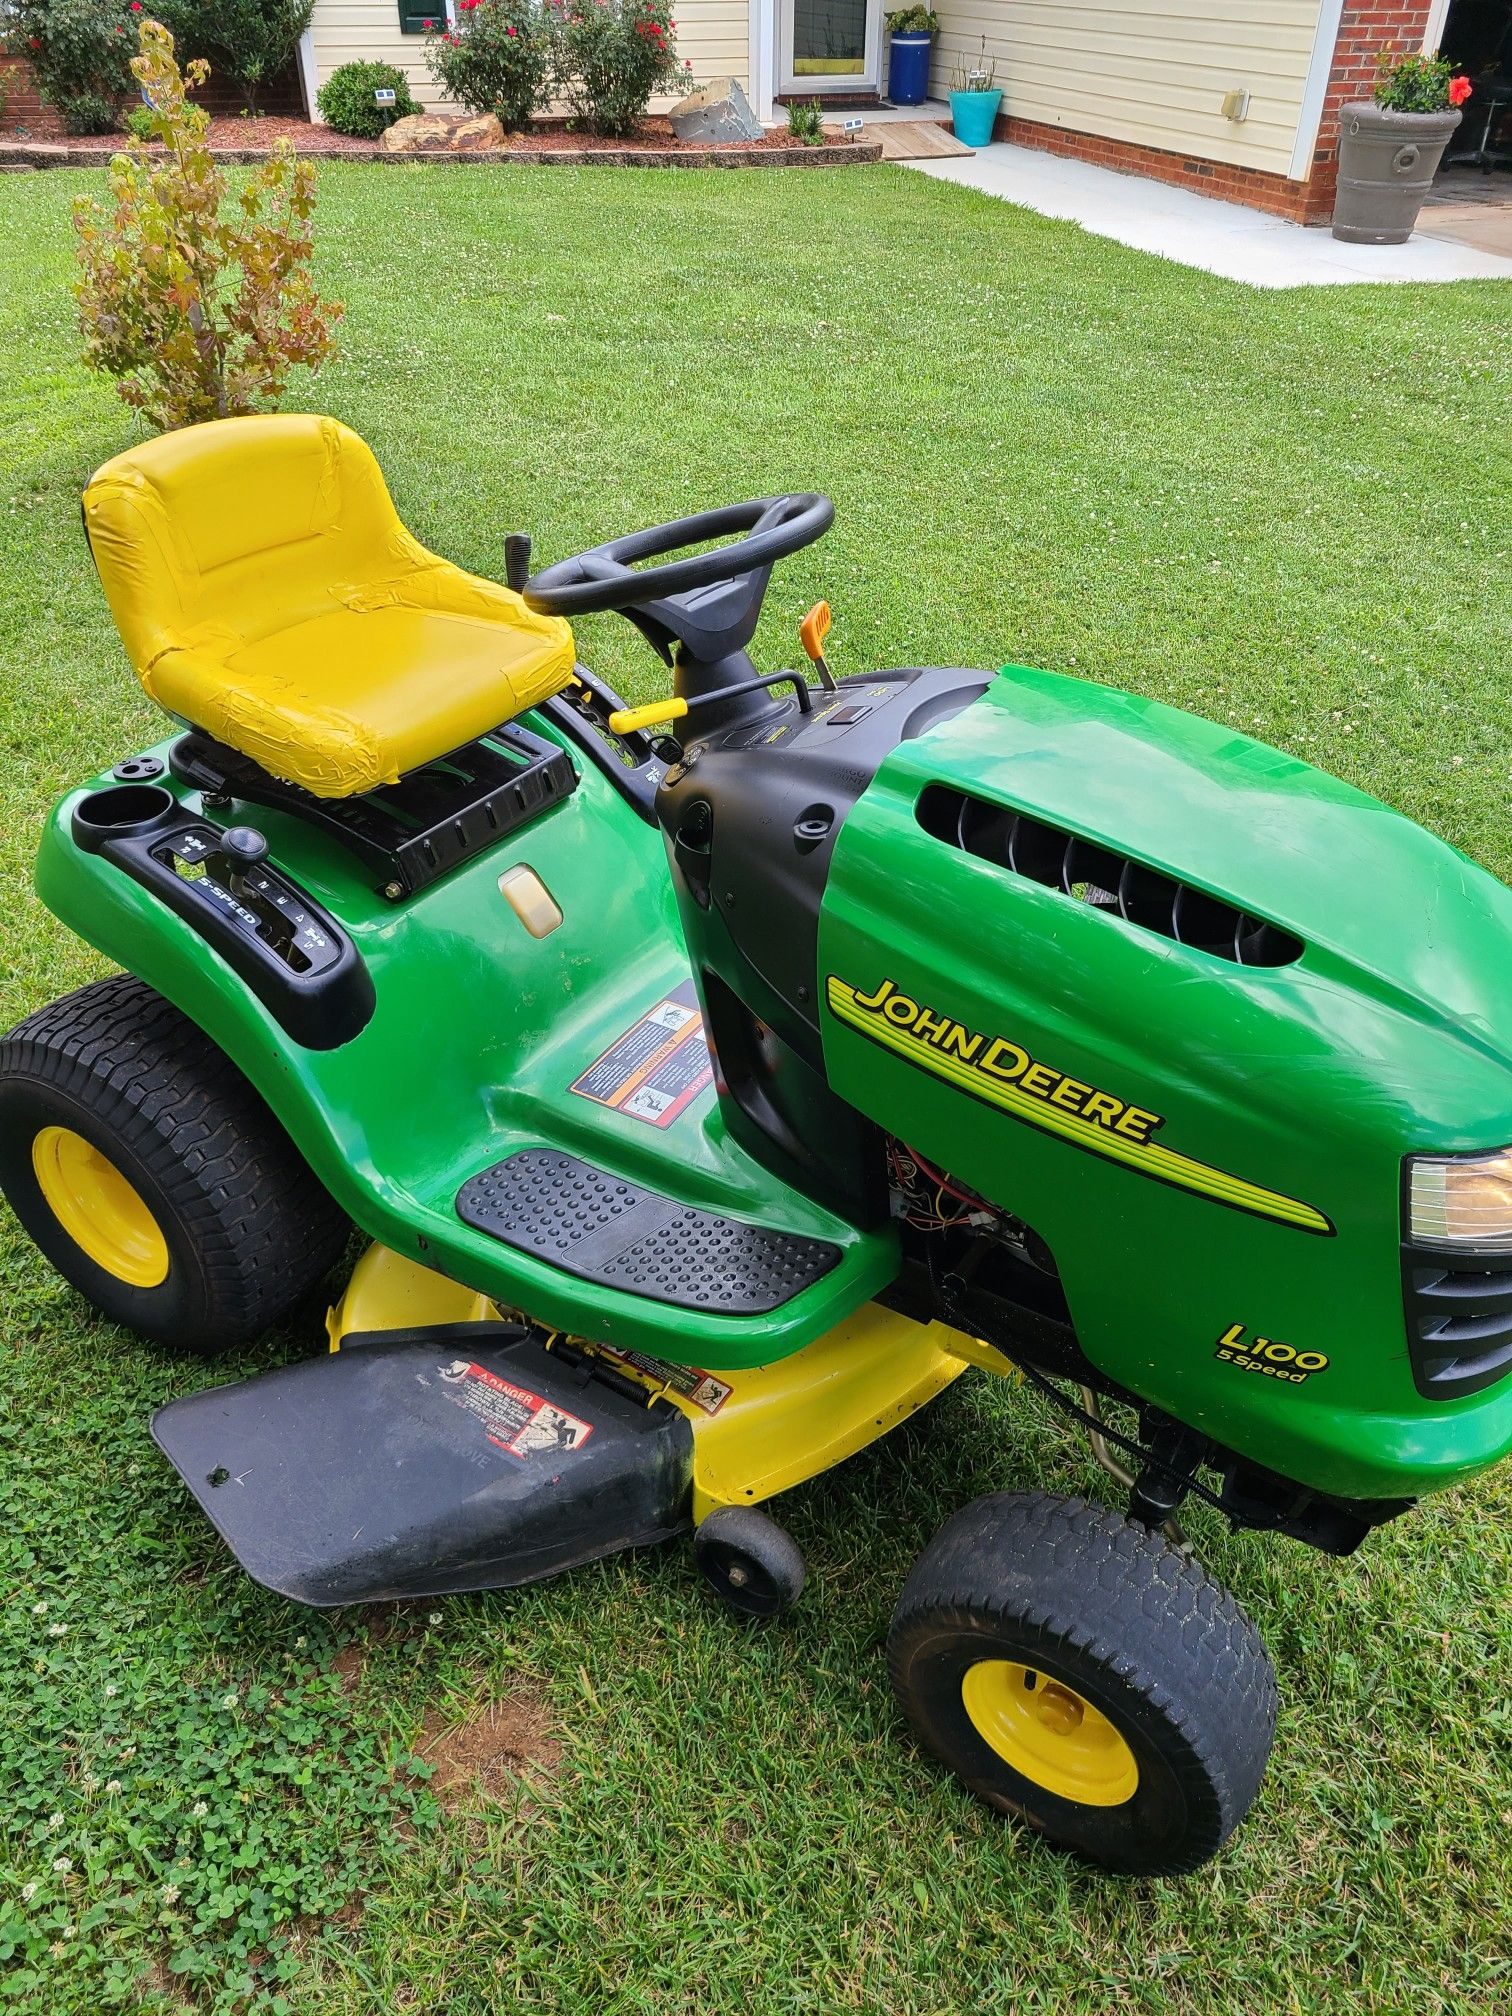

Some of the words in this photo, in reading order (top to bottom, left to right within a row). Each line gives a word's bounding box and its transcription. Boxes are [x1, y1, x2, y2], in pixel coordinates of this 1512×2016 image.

[198, 877, 256, 925] 5-SPEED
[639, 1043, 673, 1075] WARNING
[855, 980, 984, 1059] JOHN
[980, 1037, 1162, 1140] DEERE
[687, 1069, 713, 1093] ANGER
[1220, 1324, 1329, 1370] L100
[1217, 1349, 1232, 1361] 5
[1232, 1355, 1308, 1384] Speed
[489, 1378, 534, 1405] DANGER
